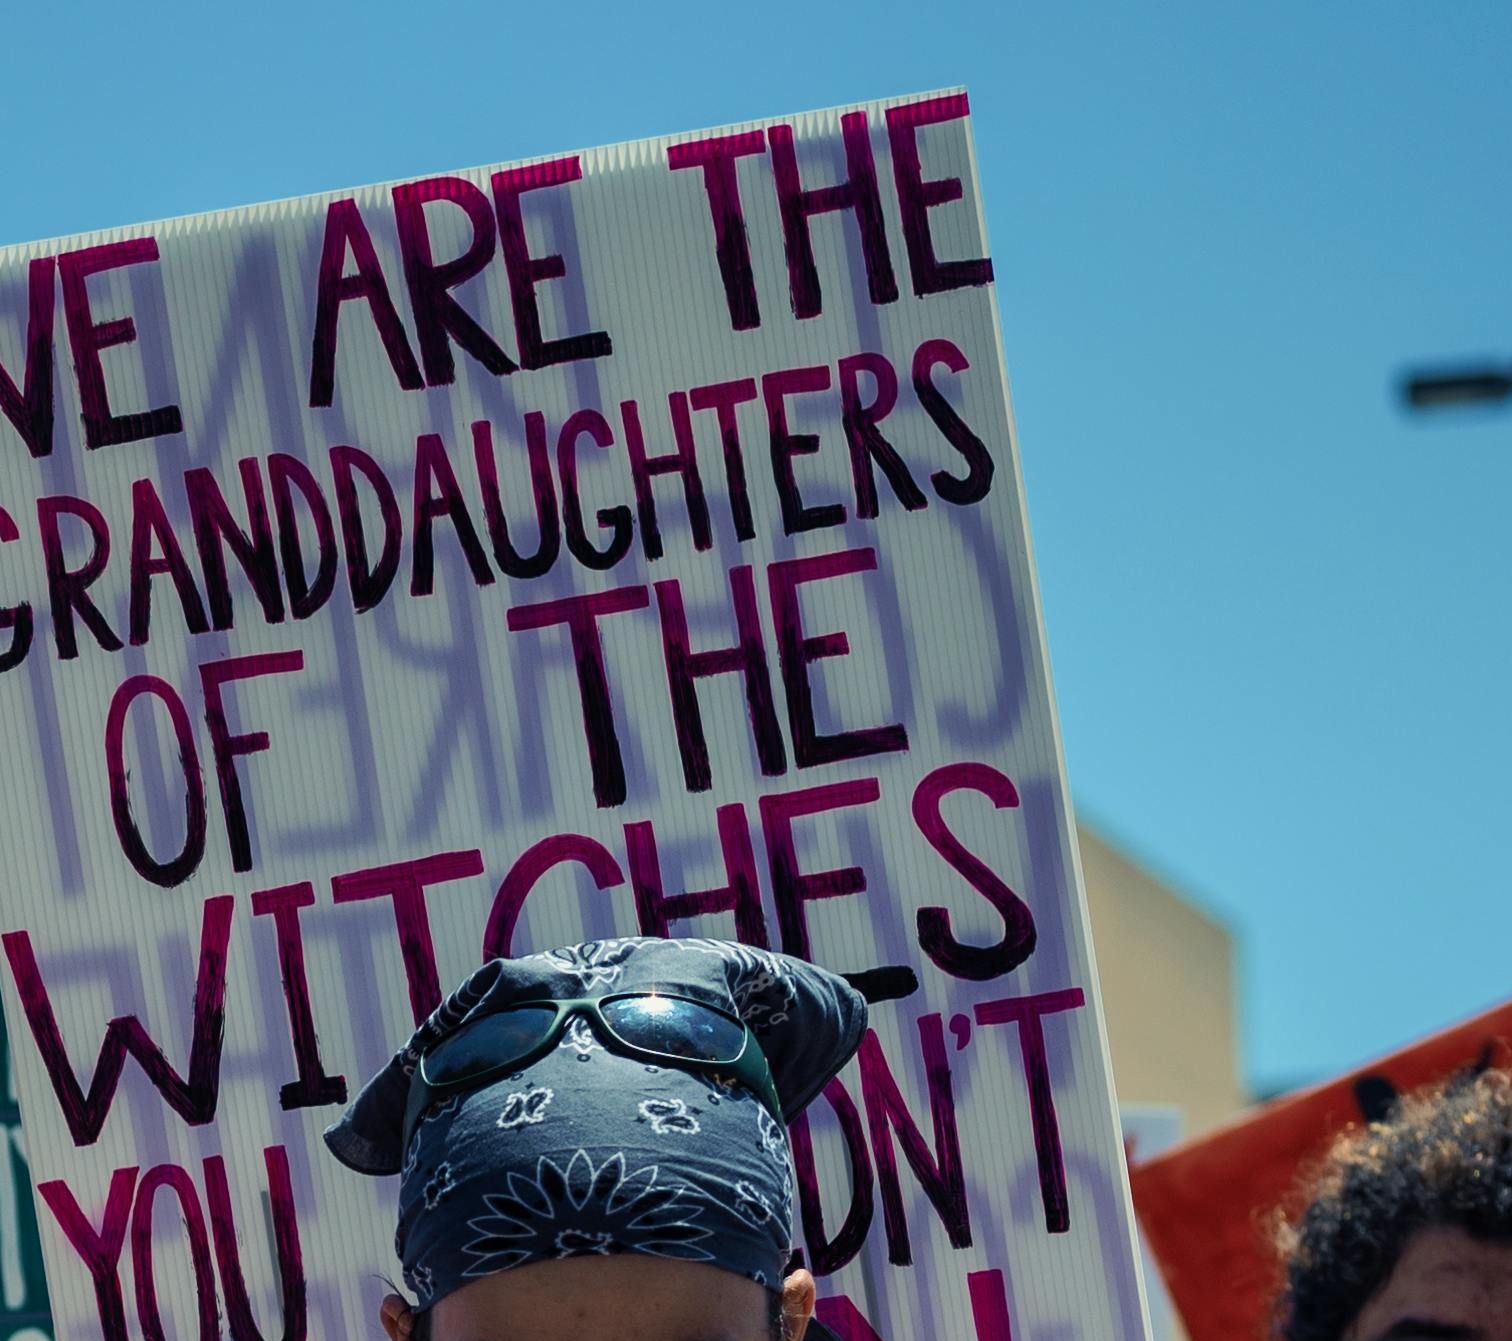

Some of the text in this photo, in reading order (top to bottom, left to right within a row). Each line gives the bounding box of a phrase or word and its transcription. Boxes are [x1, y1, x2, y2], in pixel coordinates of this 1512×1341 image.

[309, 155, 612, 409] ARE
[667, 92, 995, 331] THE
[105, 547, 908, 889] OF THE
[2, 762, 1039, 1147] WITCHES
[783, 988, 1085, 1276] DN'T
